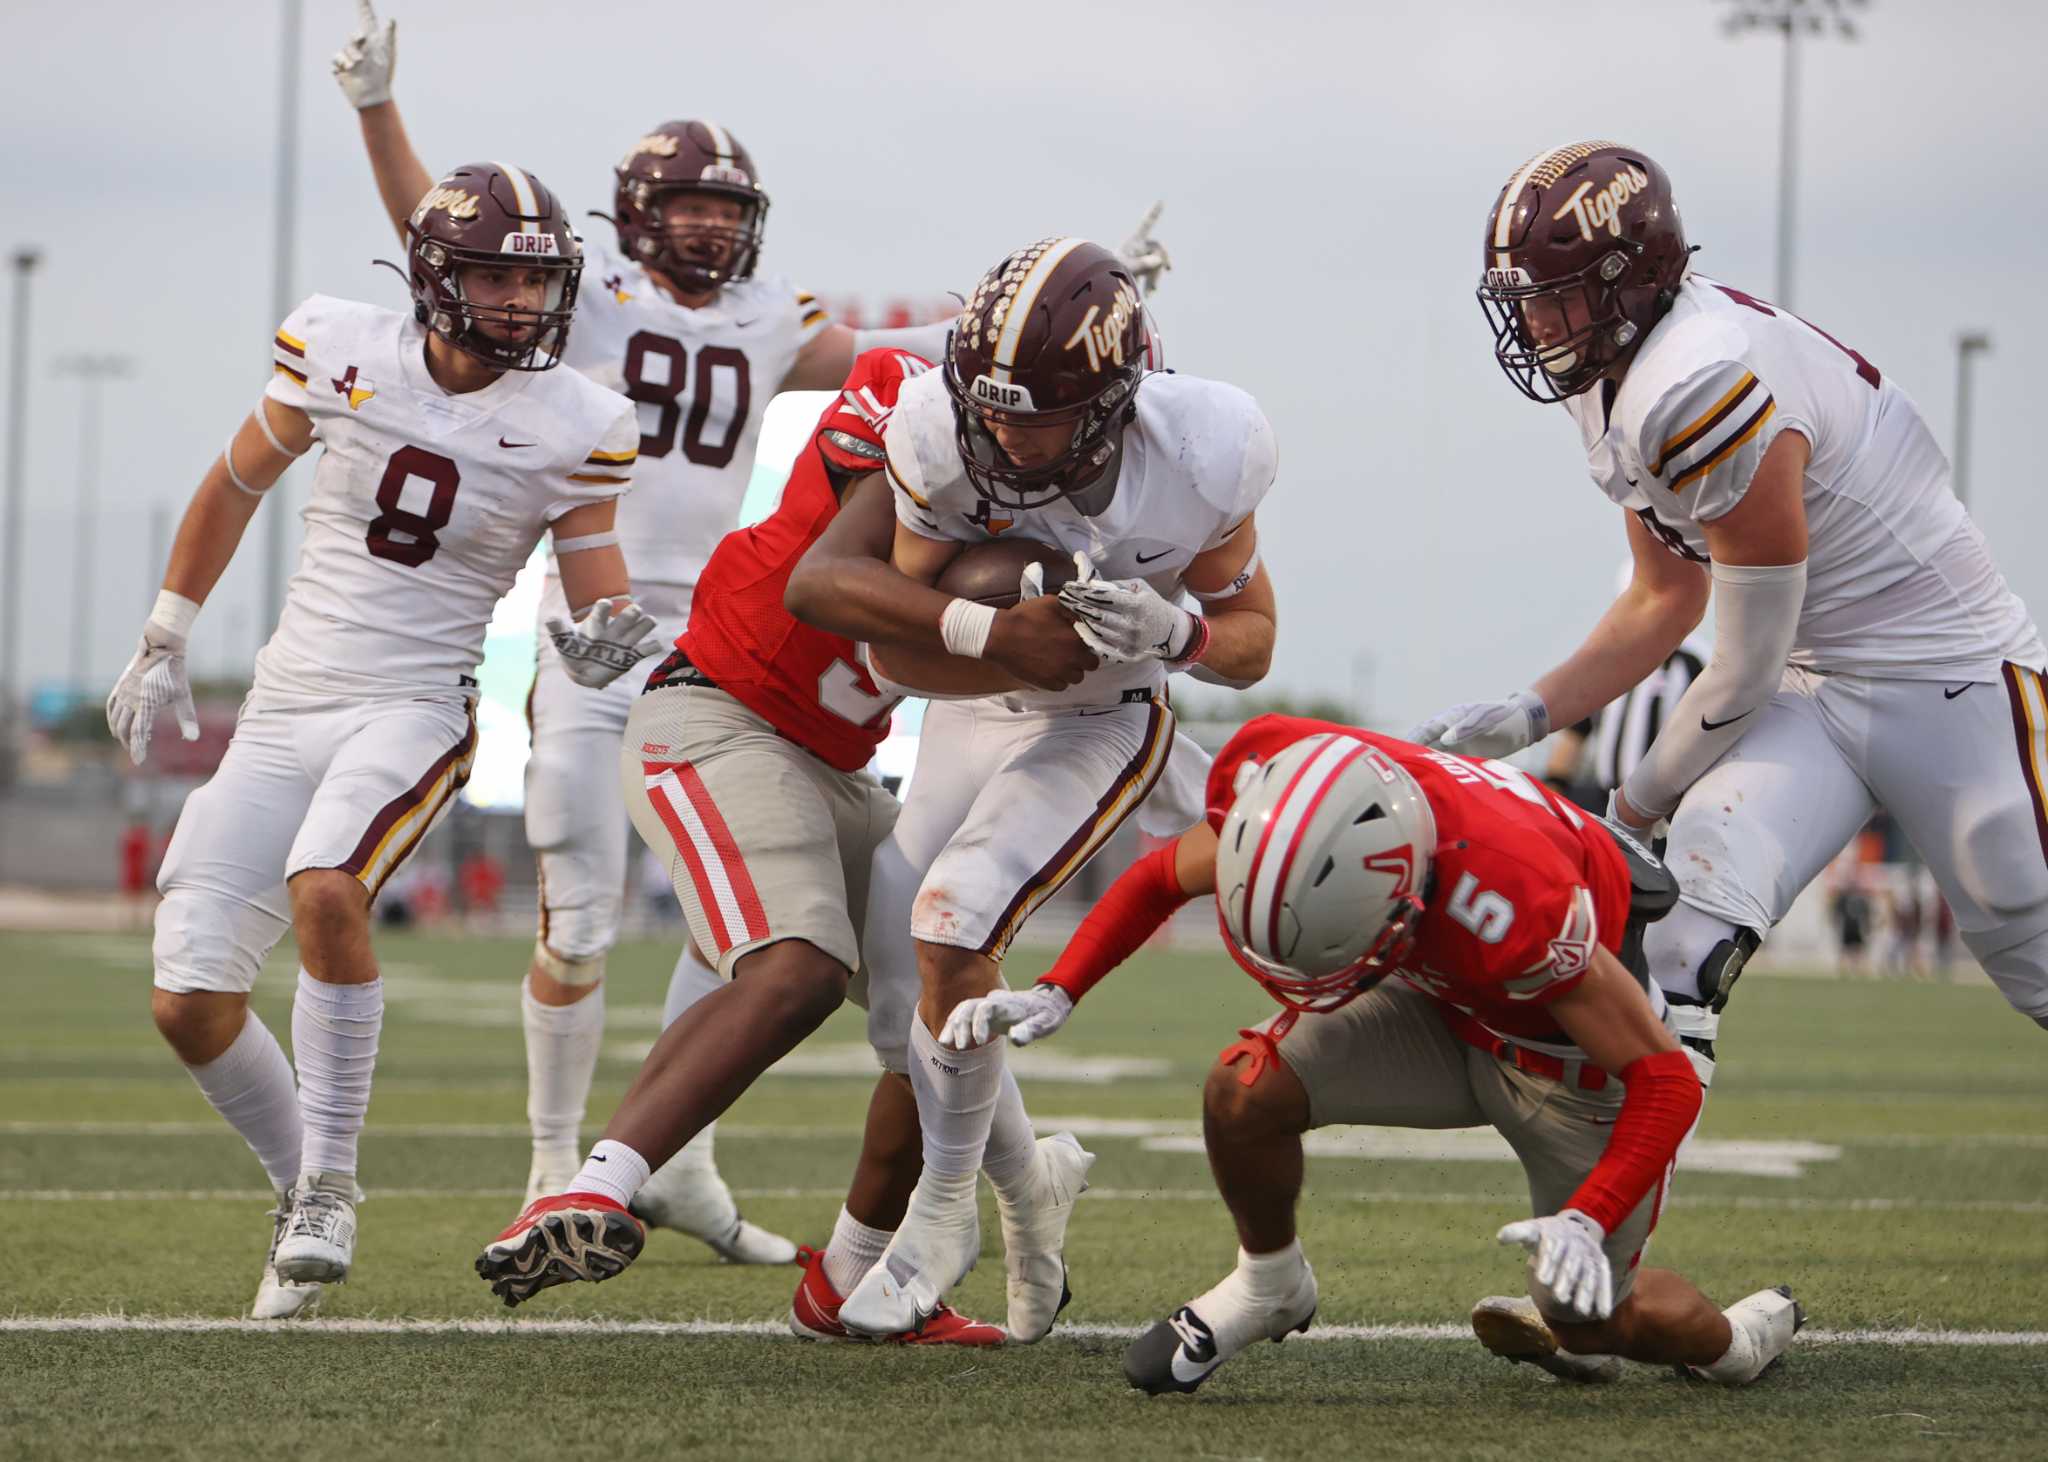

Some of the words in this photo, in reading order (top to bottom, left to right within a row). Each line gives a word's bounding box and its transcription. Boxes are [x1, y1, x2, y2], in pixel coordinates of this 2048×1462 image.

[1552, 164, 1649, 242] Tigers
[513, 235, 553, 253] DRIP
[1489, 270, 1520, 288] DRIP
[623, 328, 751, 470] 80
[977, 379, 1021, 407] DRIP
[365, 443, 462, 569] 8
[1446, 869, 1516, 944] 5
